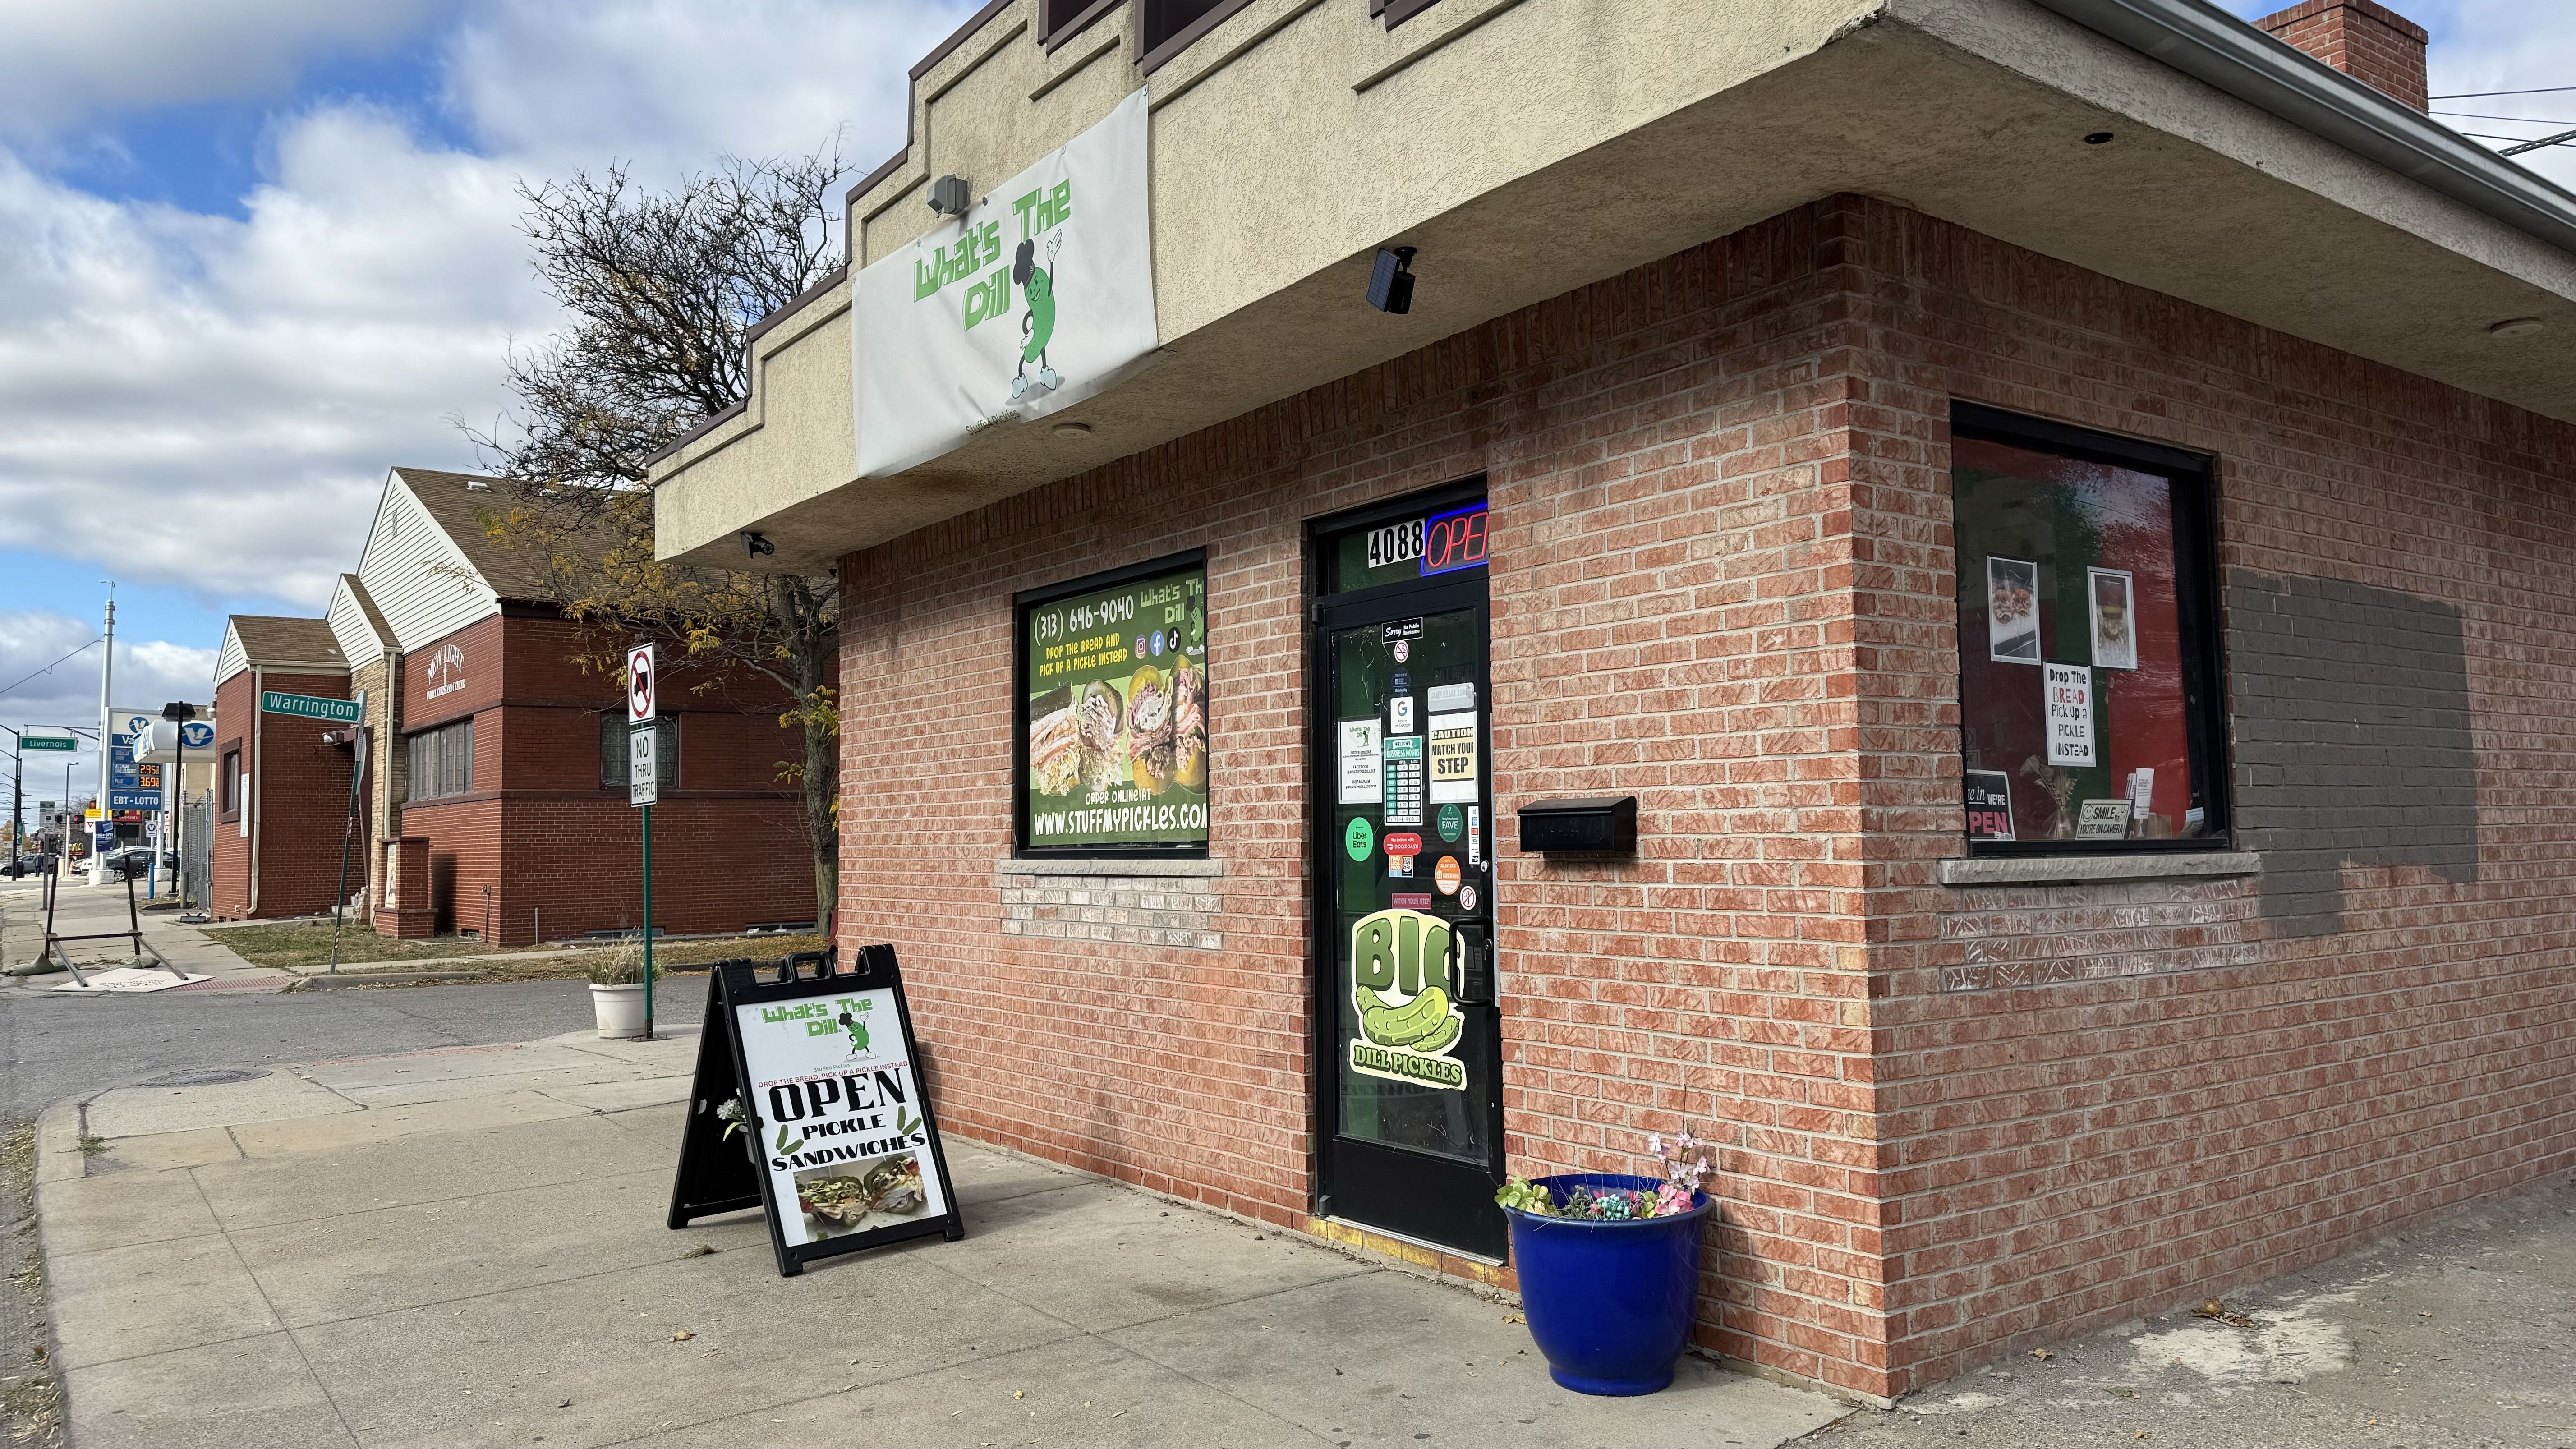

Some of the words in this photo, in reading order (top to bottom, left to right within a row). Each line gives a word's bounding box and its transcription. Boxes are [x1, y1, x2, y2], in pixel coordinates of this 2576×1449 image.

[914, 220, 1001, 303] What's
[1013, 178, 1072, 244] The
[963, 264, 1011, 332] Dill
[966, 417, 993, 435] Stuffed
[992, 410, 1020, 425] Pickles
[1370, 520, 1423, 565] 4088
[1141, 584, 1180, 607] What's
[1186, 578, 1204, 596] Th
[1034, 608, 1064, 646] (313)
[1070, 595, 1134, 632] 646-9040
[1165, 603, 1185, 624] Dill
[1385, 627, 1402, 637] Sorry
[1046, 645, 1063, 660] DROP
[1106, 632, 1120, 648] AND
[444, 644, 464, 673] LIGHT
[1040, 662, 1053, 676] PICK
[1056, 661, 1064, 674] UP
[1066, 660, 1071, 672] A
[2050, 669, 2069, 685] Drop
[2071, 670, 2086, 684] The
[2053, 686, 2084, 704] BREAD
[271, 695, 354, 717] Warrington
[2052, 704, 2068, 717] Pick
[2070, 706, 2080, 721] Up
[2083, 708, 2087, 719] a
[1432, 728, 1473, 740] CAUTION
[2058, 724, 2085, 737] PICKLE
[636, 737, 649, 759] NO
[1386, 749, 1405, 758] BUSINESS
[1406, 749, 1420, 757] HOURS
[2056, 742, 2089, 756] INSTEAD
[140, 765, 156, 774] 2.95
[635, 763, 651, 778] THRU
[1438, 757, 1468, 774] STEP
[140, 777, 156, 787] 3.69
[632, 784, 654, 798] TRAFFIC
[135, 796, 158, 805] LOTTO
[1141, 787, 1151, 801] AT
[1977, 786, 1985, 801] in
[1987, 794, 2006, 805] WE'RE
[1969, 811, 2009, 833] PEN
[2093, 807, 2116, 820] SMILE
[1442, 821, 1458, 829] FAVE
[2080, 824, 2096, 834] YOU'RE
[2097, 824, 2103, 833] ON
[2104, 824, 2123, 834] CAMERA
[760, 1003, 828, 1023] What's
[835, 998, 873, 1013] The
[805, 1018, 839, 1037] Dill
[759, 1080, 778, 1088] DROP
[795, 1074, 820, 1082] BREAD,
[856, 1066, 879, 1074] PICKLE
[880, 1061, 908, 1070] INSTEAD
[1354, 1045, 1390, 1072] DILL
[1391, 1053, 1462, 1086] PICKLES
[768, 1068, 906, 1122] OPEN
[802, 1114, 886, 1140] PICKLE
[772, 1133, 926, 1171] SANDWICHES
